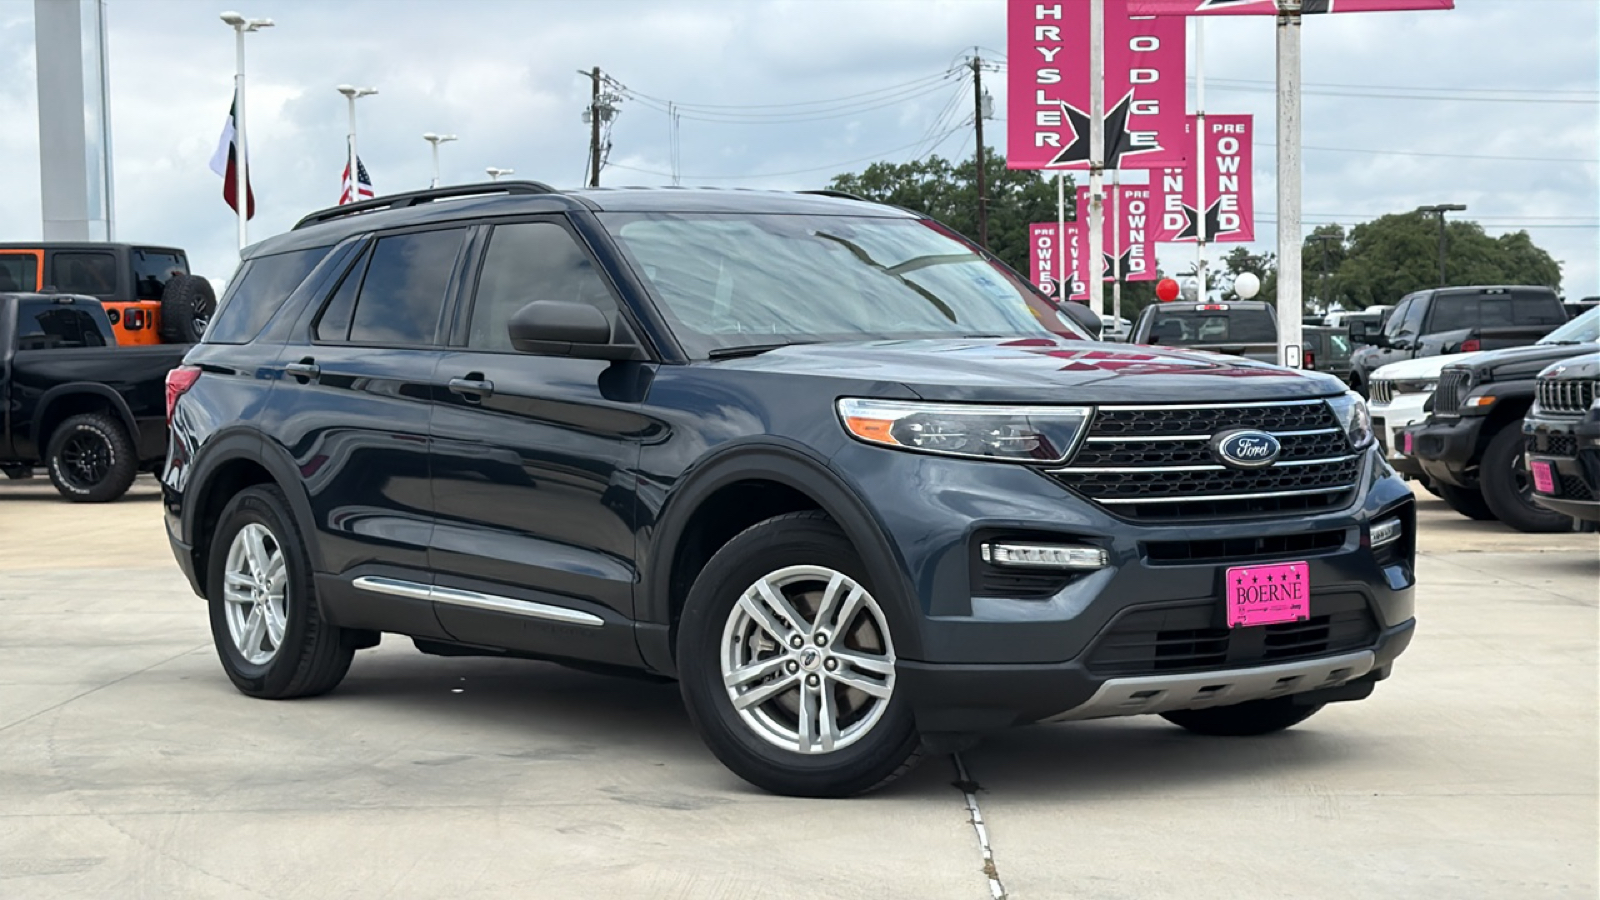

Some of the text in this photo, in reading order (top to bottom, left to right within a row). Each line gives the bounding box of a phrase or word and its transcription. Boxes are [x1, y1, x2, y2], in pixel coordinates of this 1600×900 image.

[1035, 4, 1062, 147] HRYSLER
[1129, 15, 1160, 147] ODGE
[1212, 124, 1245, 133] PRE
[1124, 190, 1150, 199] PRE
[1163, 169, 1184, 230] NED
[1215, 137, 1241, 230] OWNED
[1037, 236, 1053, 294] OWNED
[1127, 200, 1147, 271] OWNED
[1236, 438, 1270, 457] Ford
[1236, 582, 1303, 605] BOERNE
